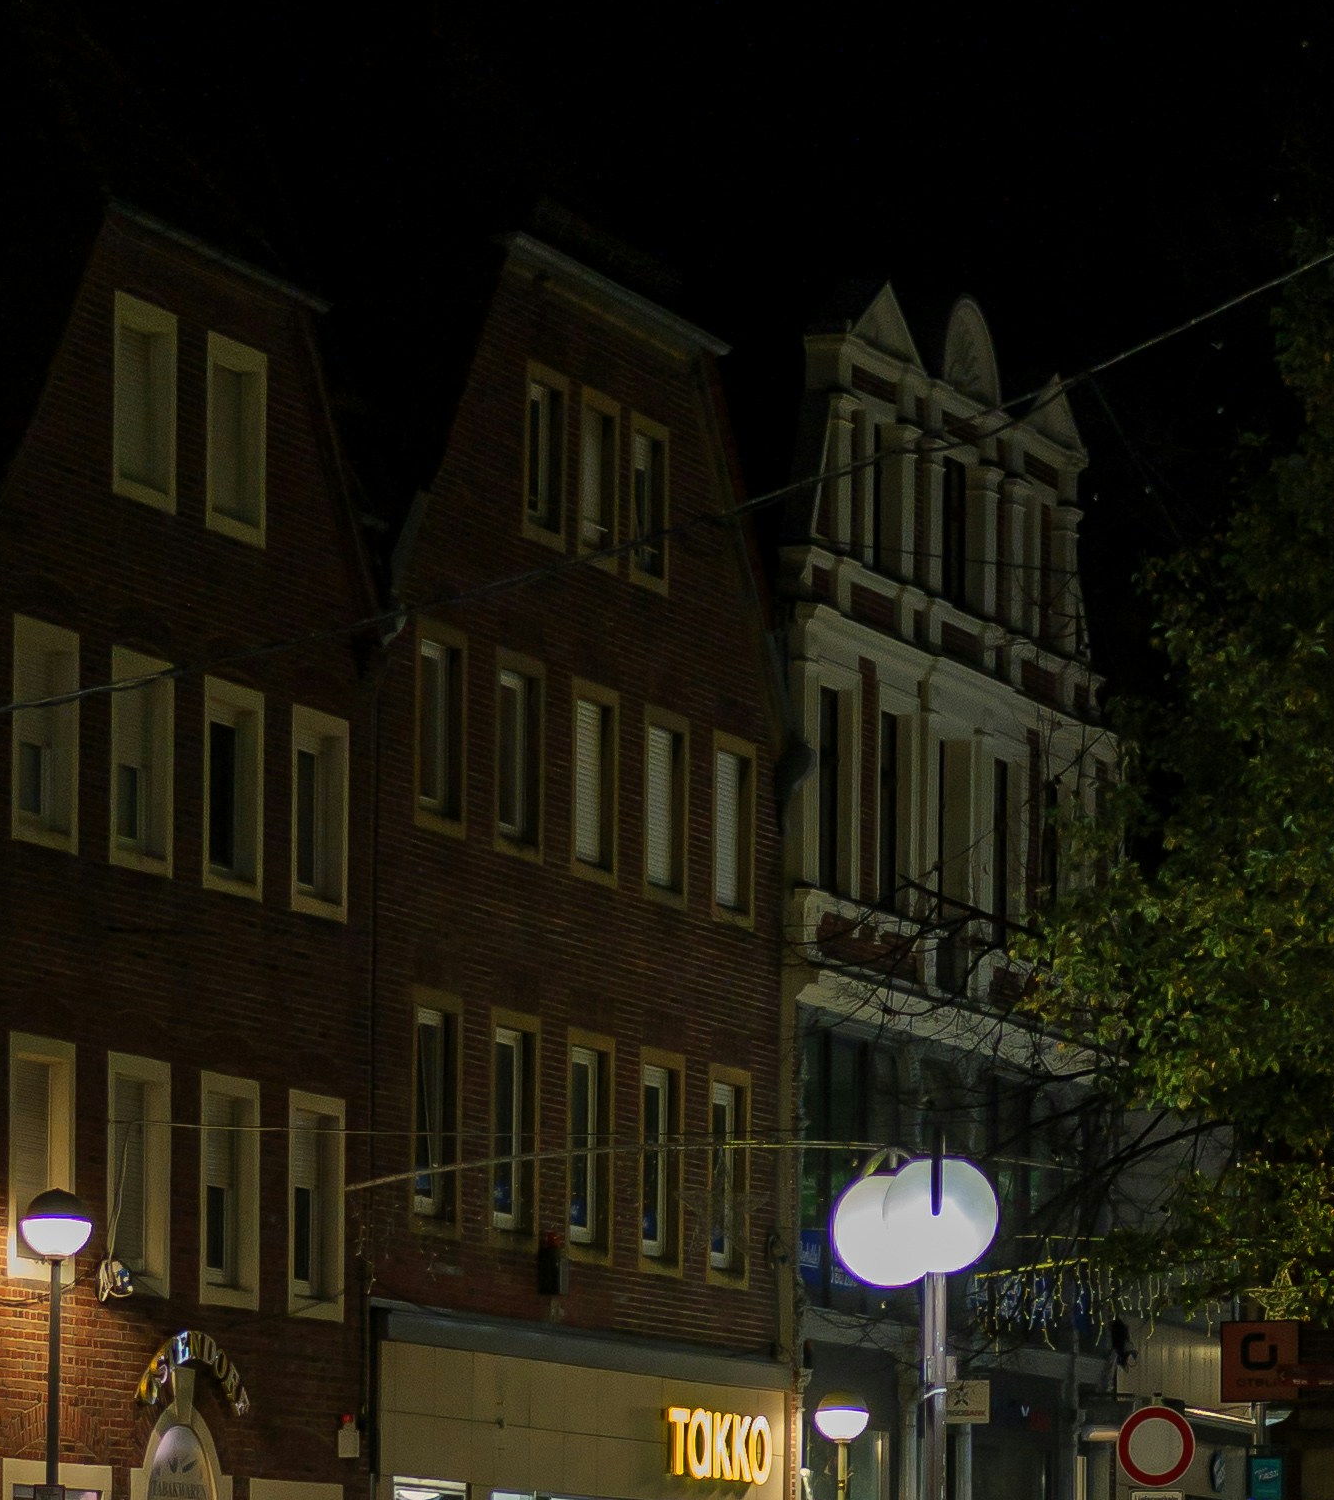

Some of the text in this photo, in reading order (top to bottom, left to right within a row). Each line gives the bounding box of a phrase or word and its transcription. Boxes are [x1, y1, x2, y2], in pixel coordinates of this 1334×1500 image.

[946, 1409, 987, 1417] RGOBANK
[666, 1406, 772, 1486] TAKKO
[150, 1479, 208, 1500] TABAKWAREN
